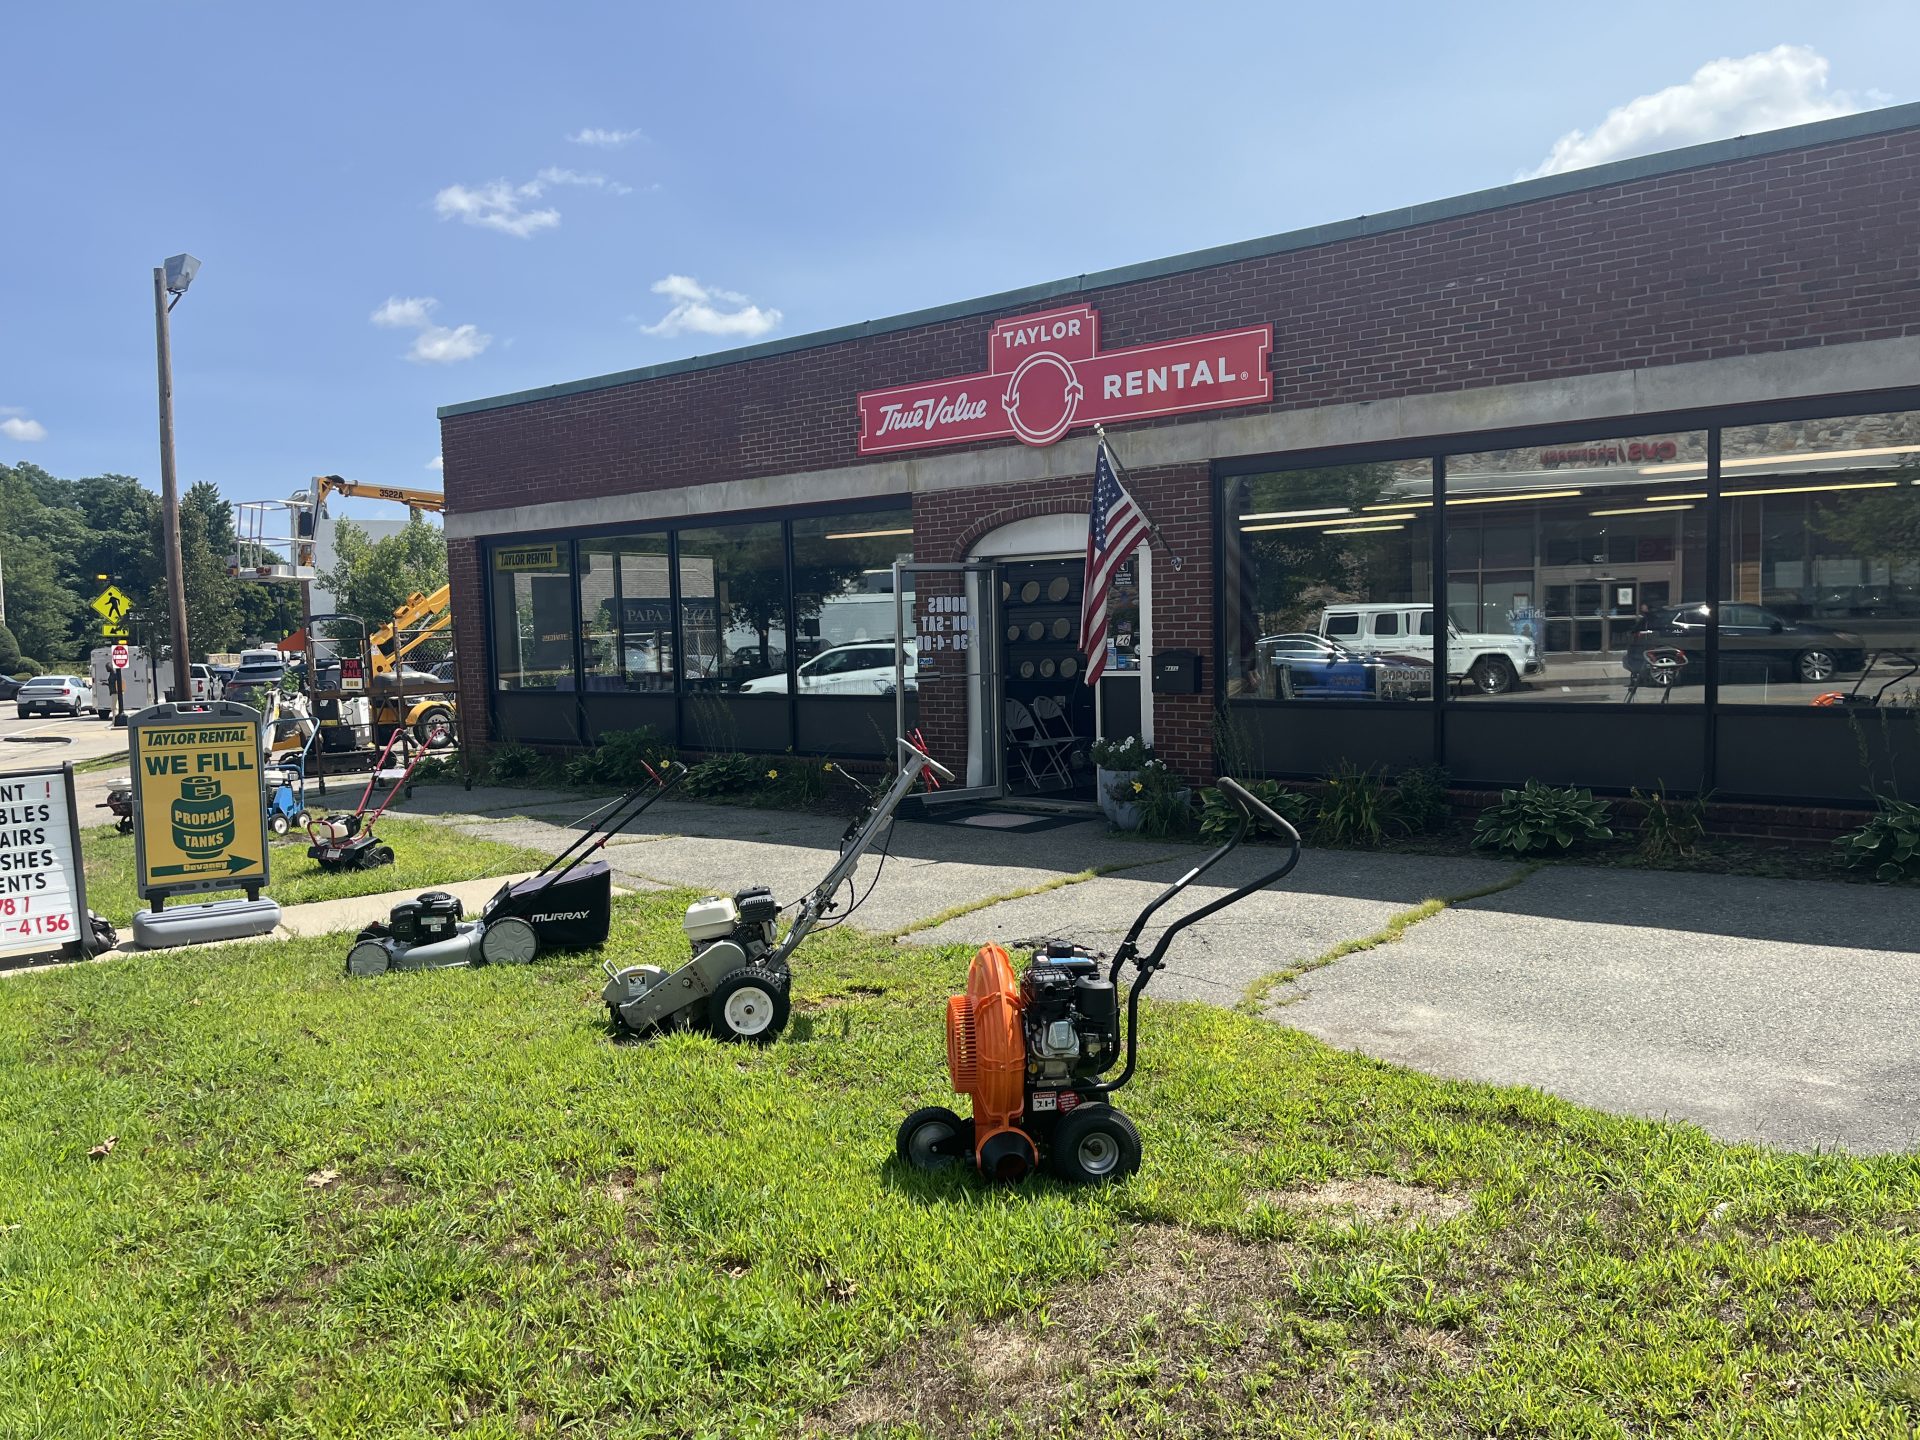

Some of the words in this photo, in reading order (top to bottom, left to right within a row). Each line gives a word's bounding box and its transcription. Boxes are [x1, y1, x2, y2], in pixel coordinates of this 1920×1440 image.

[1002, 319, 1081, 349] TAYLOR
[1103, 356, 1236, 400] RENTAL
[379, 489, 404, 499] 3522A
[500, 551, 525, 567] TAYLOR
[526, 551, 553, 565] RENTAL
[627, 609, 664, 621] PAPA
[1117, 634, 1131, 647] 26
[345, 660, 358, 669] FOR
[342, 669, 362, 678] SALE
[145, 730, 197, 747] TAYLOR
[199, 729, 247, 744] RENTAL
[145, 755, 188, 776] WE
[197, 751, 254, 773] FILL
[174, 806, 230, 825] PROPANE
[0, 827, 46, 849] AIRS
[183, 832, 224, 848] TANKS
[0, 849, 53, 871] SHES
[531, 910, 590, 923] MURRAY
